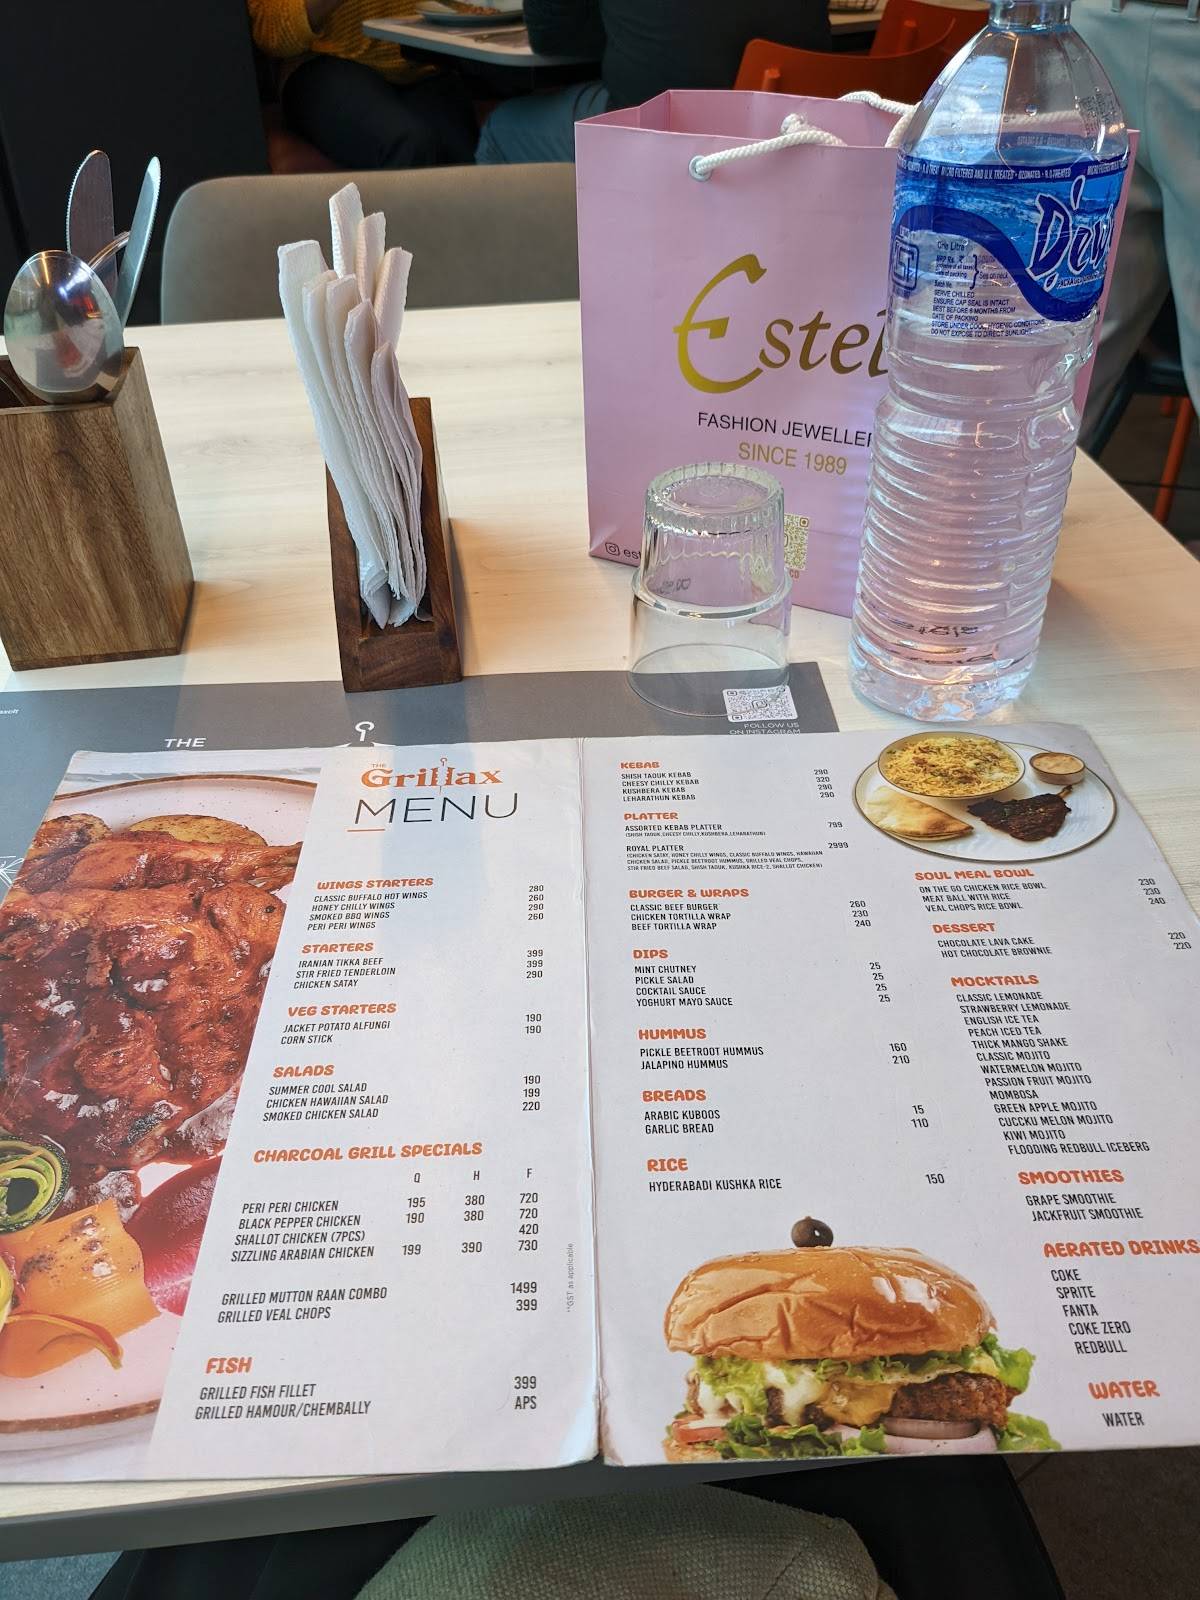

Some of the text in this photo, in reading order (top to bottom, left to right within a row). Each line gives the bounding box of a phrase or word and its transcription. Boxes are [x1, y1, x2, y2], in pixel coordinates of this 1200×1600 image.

[955, 169, 973, 179] FILTERED
[974, 170, 983, 179] AND
[994, 170, 1014, 180] TREATED
[947, 306, 968, 314] BEFORE
[954, 314, 979, 322] PACKING
[951, 330, 974, 338] EXPOSE
[974, 330, 982, 338] TO
[983, 330, 1005, 338] DIRECT
[698, 411, 872, 448] FASHION JEWELLE
[739, 442, 847, 475] SINCE 1989
[164, 738, 207, 749] THE
[361, 766, 503, 788] Grillax
[621, 772, 642, 780] SHISH
[667, 771, 691, 779] KEBAB
[355, 793, 518, 825] MENU
[624, 812, 678, 821] PLATTER
[651, 844, 684, 852] PLATTER
[915, 868, 1034, 881] SOUL MEAL BOWL
[317, 877, 433, 890] WINGS STARTERS
[314, 891, 428, 903] CLASSIC BUFFALO HOT WINGS
[629, 888, 749, 898] BURGER & WRAPS
[630, 903, 719, 912] CLASSIC BEEF BURGER
[933, 923, 995, 933] DESSERT
[938, 936, 1034, 948] CHOCOLATE LAVA CAKE
[1168, 932, 1186, 940] 220
[302, 942, 374, 954] STARTERS
[633, 949, 669, 959] DIPS
[299, 957, 383, 969] IRANIAN TIKKA BEEF
[635, 964, 697, 974] MINT CHUTNEY
[869, 962, 881, 970] 25
[526, 971, 543, 979] 290
[951, 975, 1040, 987] MOCKTAILS
[294, 979, 358, 990] CHICKEN SATAY
[288, 1003, 397, 1018] VEG STARTERS
[525, 1025, 542, 1034] 190
[638, 1029, 707, 1040] HUMMUS
[281, 1034, 333, 1045] CORN STICK
[641, 1059, 728, 1070] JALAPINO HUMMUS
[892, 1055, 910, 1064] 210
[273, 1065, 334, 1078] SALADS
[980, 1062, 1082, 1074] WATERMELON MOJITO
[524, 1075, 541, 1084] 190
[269, 1082, 367, 1096] SUMMER COOL SALAD
[989, 1090, 1039, 1100] MOMBOSA
[642, 1089, 707, 1102] BREADS
[644, 1109, 720, 1121] ARABIC KUBOOS
[912, 1105, 924, 1115] 15
[254, 1142, 482, 1163] CHARCOAL GRILL SPECIALS
[1007, 1142, 1150, 1155] FLOODING REDBULL ICEBERG
[647, 1158, 689, 1172] RICE
[414, 1173, 420, 1183] Q
[473, 1171, 480, 1181] H
[527, 1169, 532, 1178] F
[926, 1174, 945, 1184] 150
[1018, 1170, 1124, 1185] SMOOTHIES
[649, 1178, 782, 1192] HYDERABADI KUSHKA RICE
[408, 1197, 426, 1208] 195
[465, 1195, 485, 1206] 380
[520, 1193, 538, 1204] 720
[242, 1200, 338, 1214] PERI PERI CHICKEN
[1032, 1207, 1143, 1222] JACKFRUIT SMOOTHIE
[519, 1224, 539, 1235] 420
[235, 1230, 366, 1245] SHALLOT CHICKEN (7PCS)
[1043, 1239, 1200, 1258] AERATED DRINKS
[1051, 1269, 1081, 1282] COKE
[1056, 1286, 1096, 1299] SPRITE
[1062, 1304, 1099, 1317] FANTA
[205, 1357, 252, 1374] FISH
[1089, 1380, 1160, 1400] WATER
[514, 1397, 537, 1410] APS
[195, 1401, 371, 1419] GRILLED HAMOUR/CHEMBALLY
[1102, 1412, 1144, 1426] WATER
